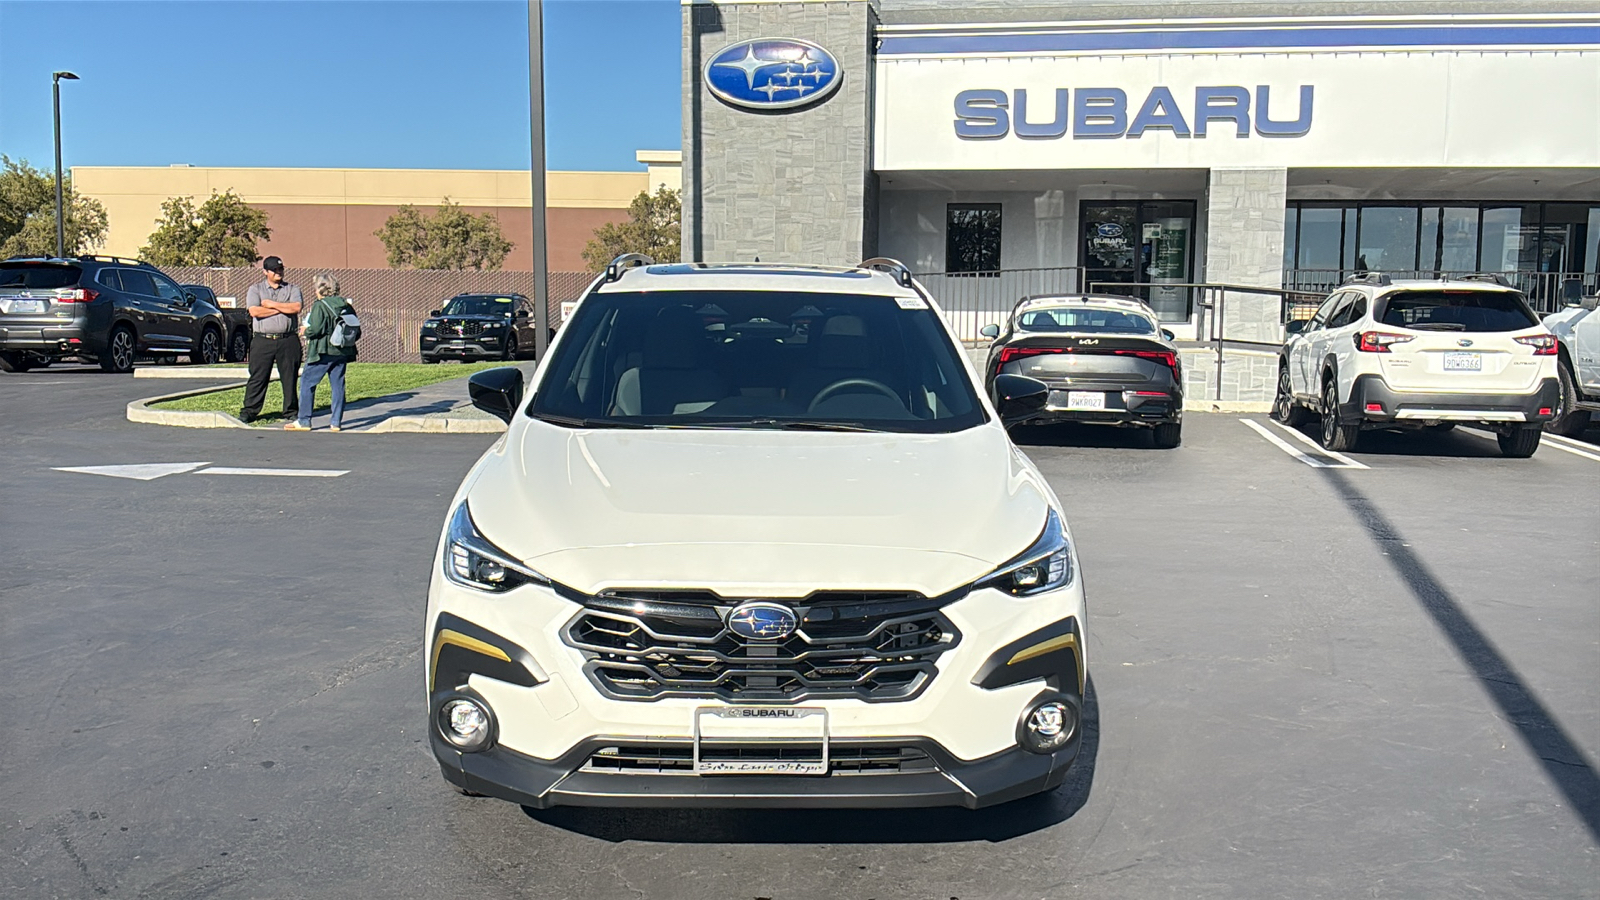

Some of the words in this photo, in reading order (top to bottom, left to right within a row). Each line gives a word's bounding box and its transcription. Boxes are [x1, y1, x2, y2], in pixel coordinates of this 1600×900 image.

[954, 85, 1314, 141] SUBARU
[1093, 237, 1128, 245] SUBARU
[742, 709, 795, 717] SUBARU
